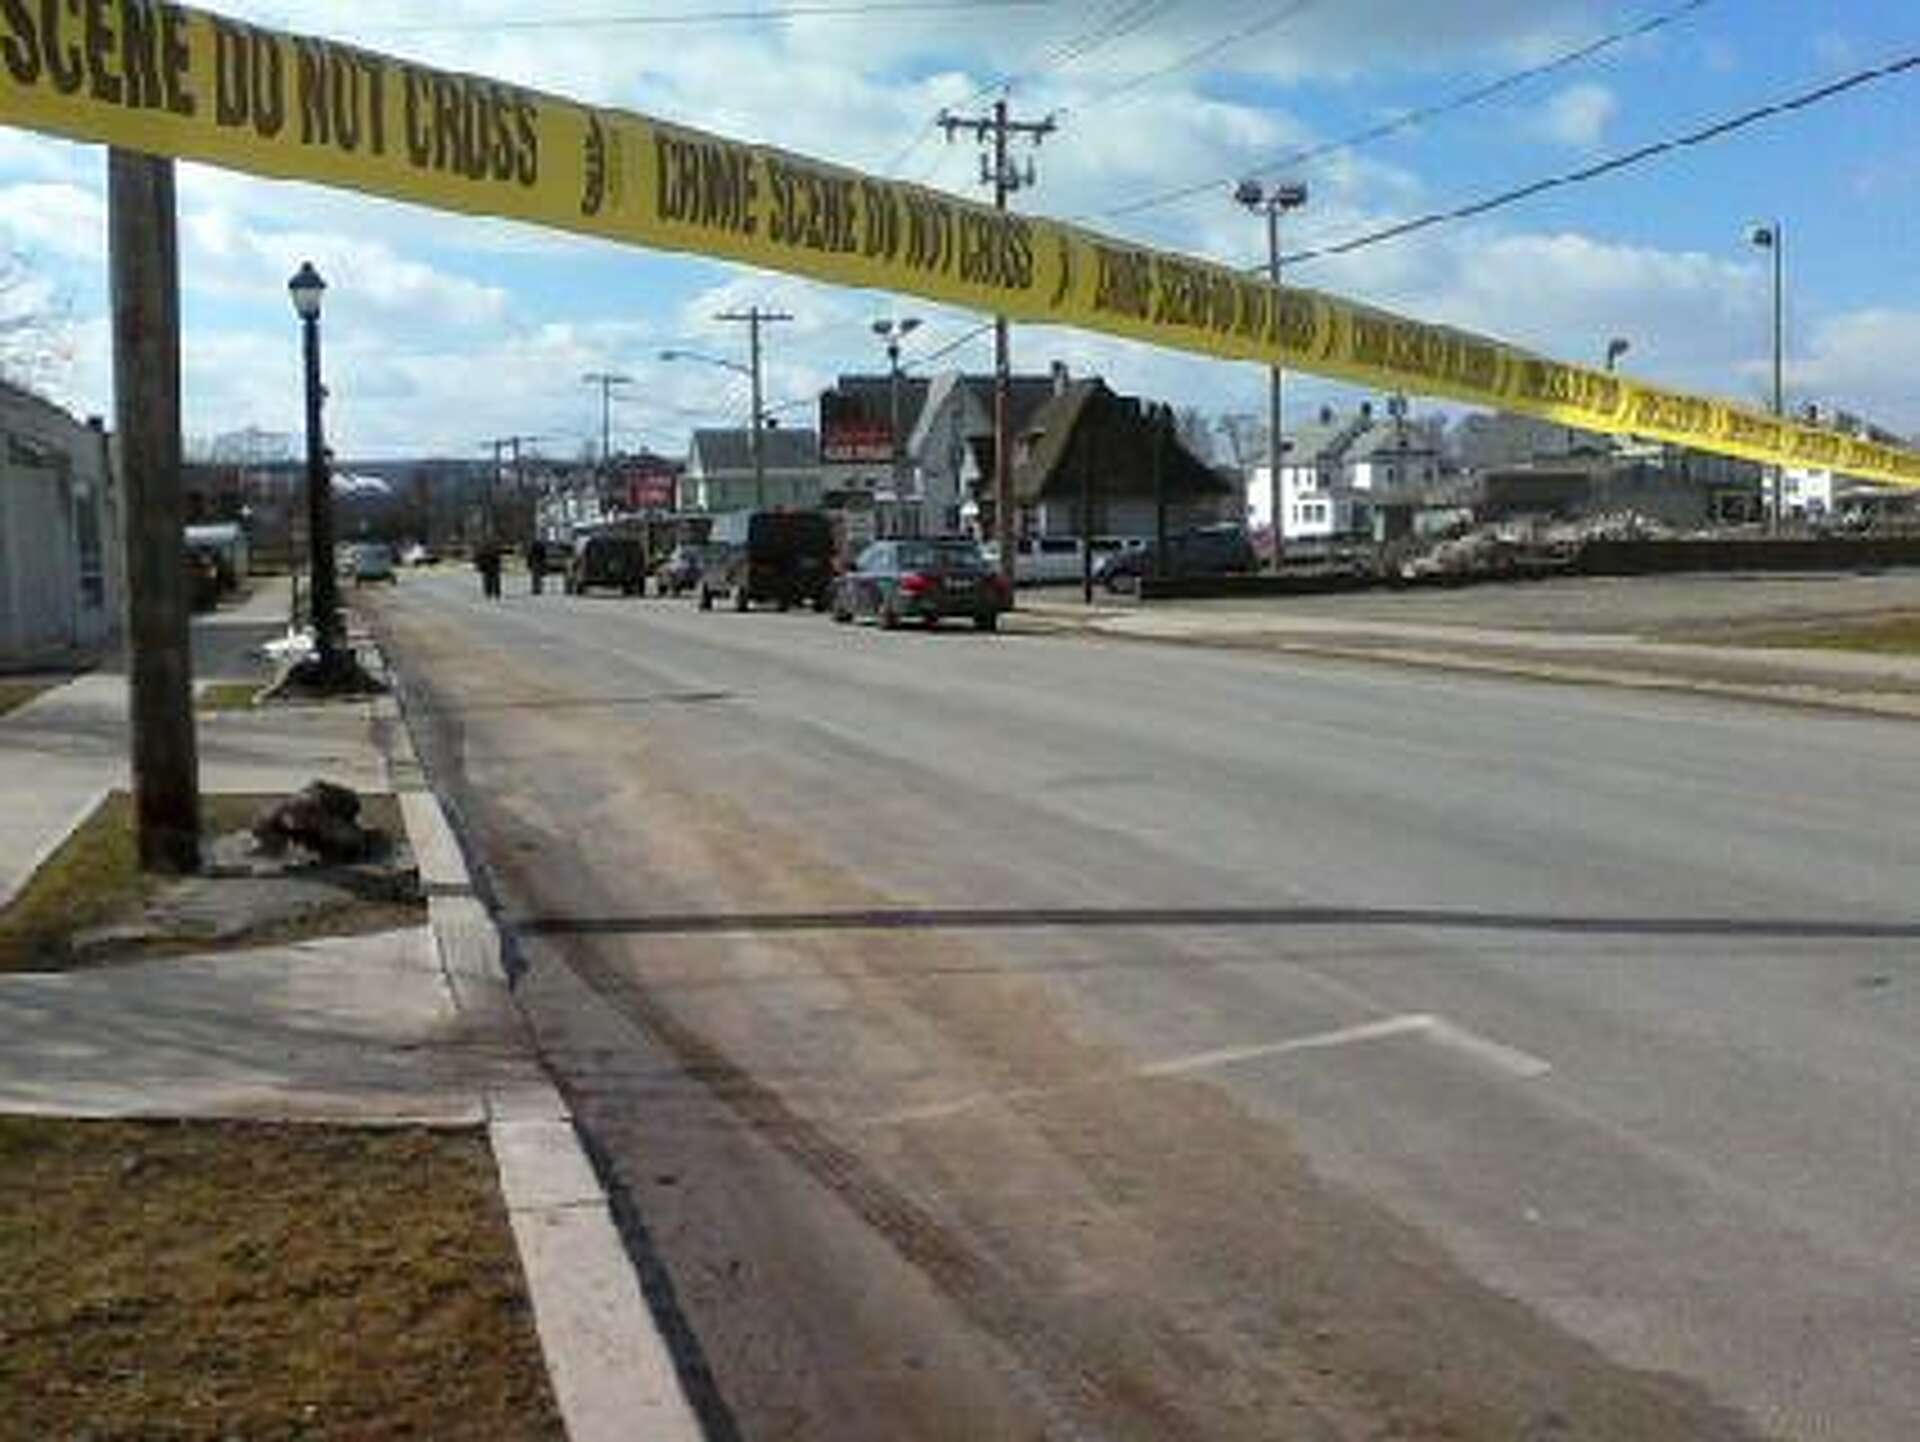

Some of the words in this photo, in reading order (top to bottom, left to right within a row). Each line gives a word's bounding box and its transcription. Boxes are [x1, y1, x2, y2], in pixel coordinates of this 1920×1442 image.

[0, 0, 195, 116] SCENE
[215, 20, 286, 138] DO
[298, 36, 388, 155] NOT
[404, 62, 539, 187] CROSS
[767, 156, 857, 253] SCENE
